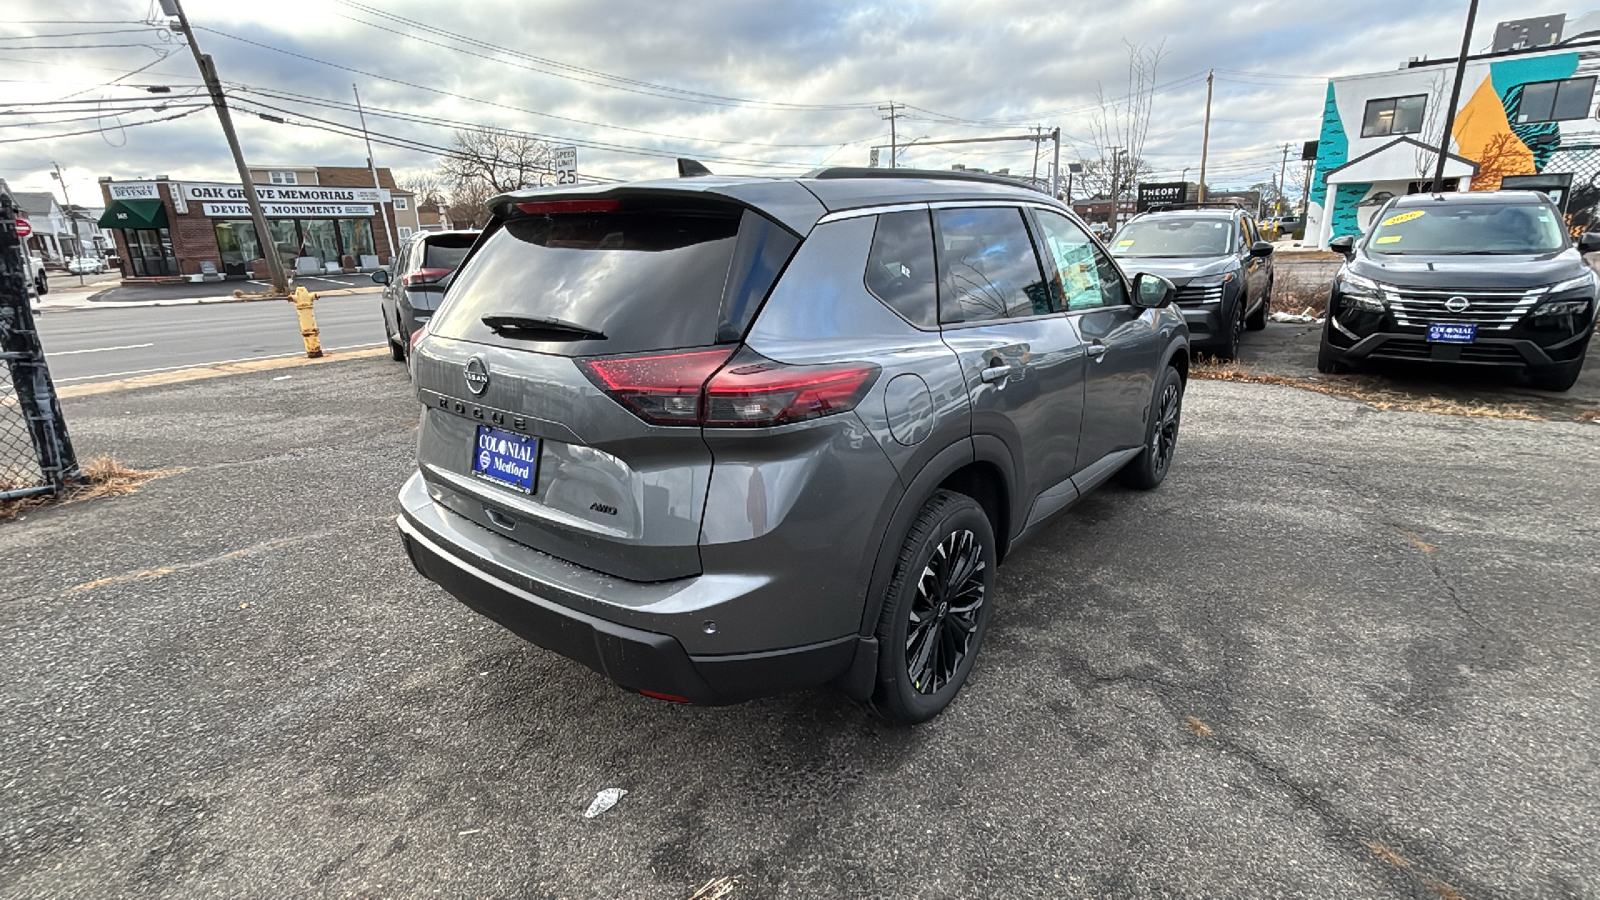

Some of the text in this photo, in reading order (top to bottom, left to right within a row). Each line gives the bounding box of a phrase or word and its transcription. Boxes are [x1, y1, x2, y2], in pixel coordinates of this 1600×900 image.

[557, 170, 576, 184] 25
[115, 189, 154, 197] DEVENEY
[191, 188, 225, 198] OAK
[227, 188, 275, 199] GRVE
[277, 189, 354, 200] MEMORIALS
[1142, 187, 1180, 196] THEORY
[210, 205, 267, 214] DEVENY
[272, 206, 343, 214] MONUMENTS
[1430, 327, 1473, 335] COLONIAL
[465, 372, 488, 383] SSAN
[439, 397, 526, 430] ROGUE
[479, 434, 534, 463] COLONIAL
[493, 456, 529, 479] Medford
[589, 502, 618, 515] AWD
